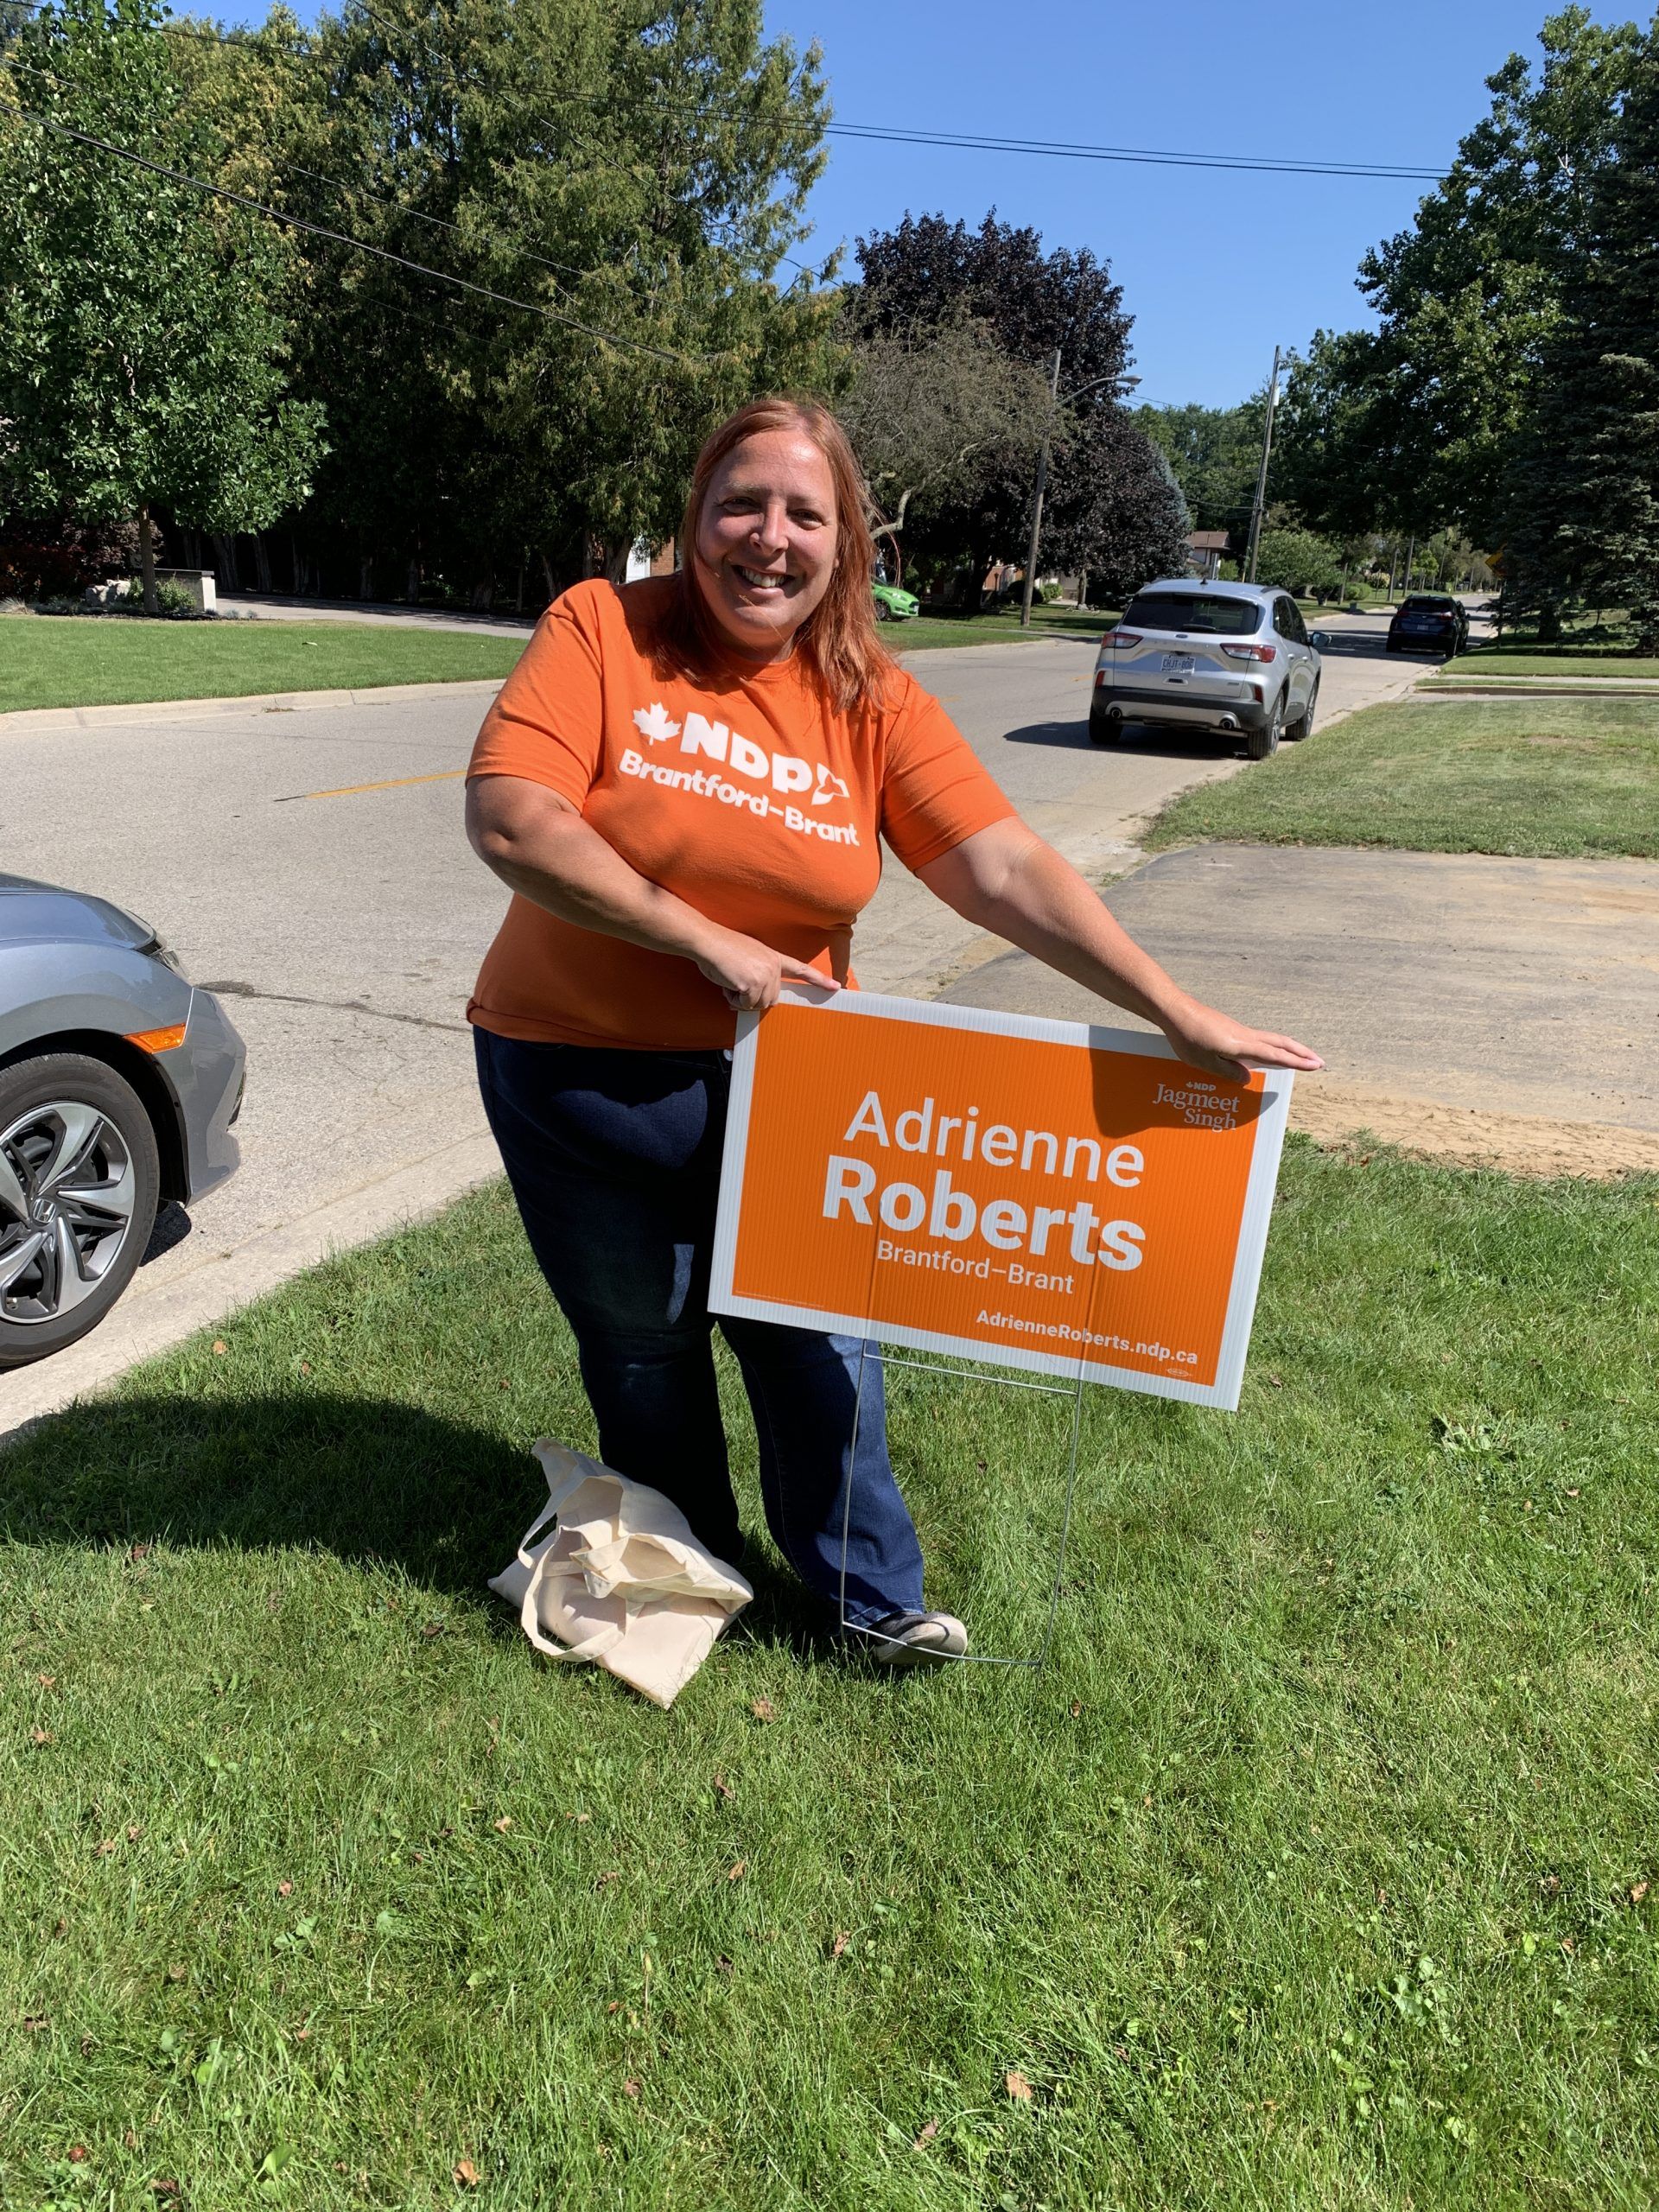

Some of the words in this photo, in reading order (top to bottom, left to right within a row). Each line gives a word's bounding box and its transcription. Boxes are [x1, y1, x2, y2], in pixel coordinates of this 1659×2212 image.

[680, 712, 813, 794] NDP
[1152, 1083, 1241, 1113] Jagmeet
[1193, 1082, 1217, 1091] NDP
[843, 1090, 1145, 1188] Adrienne
[1184, 1108, 1236, 1133] Singh
[822, 1154, 1147, 1271] Roberts
[976, 1309, 1198, 1365] AdrienneRoberts.ndp.ca
